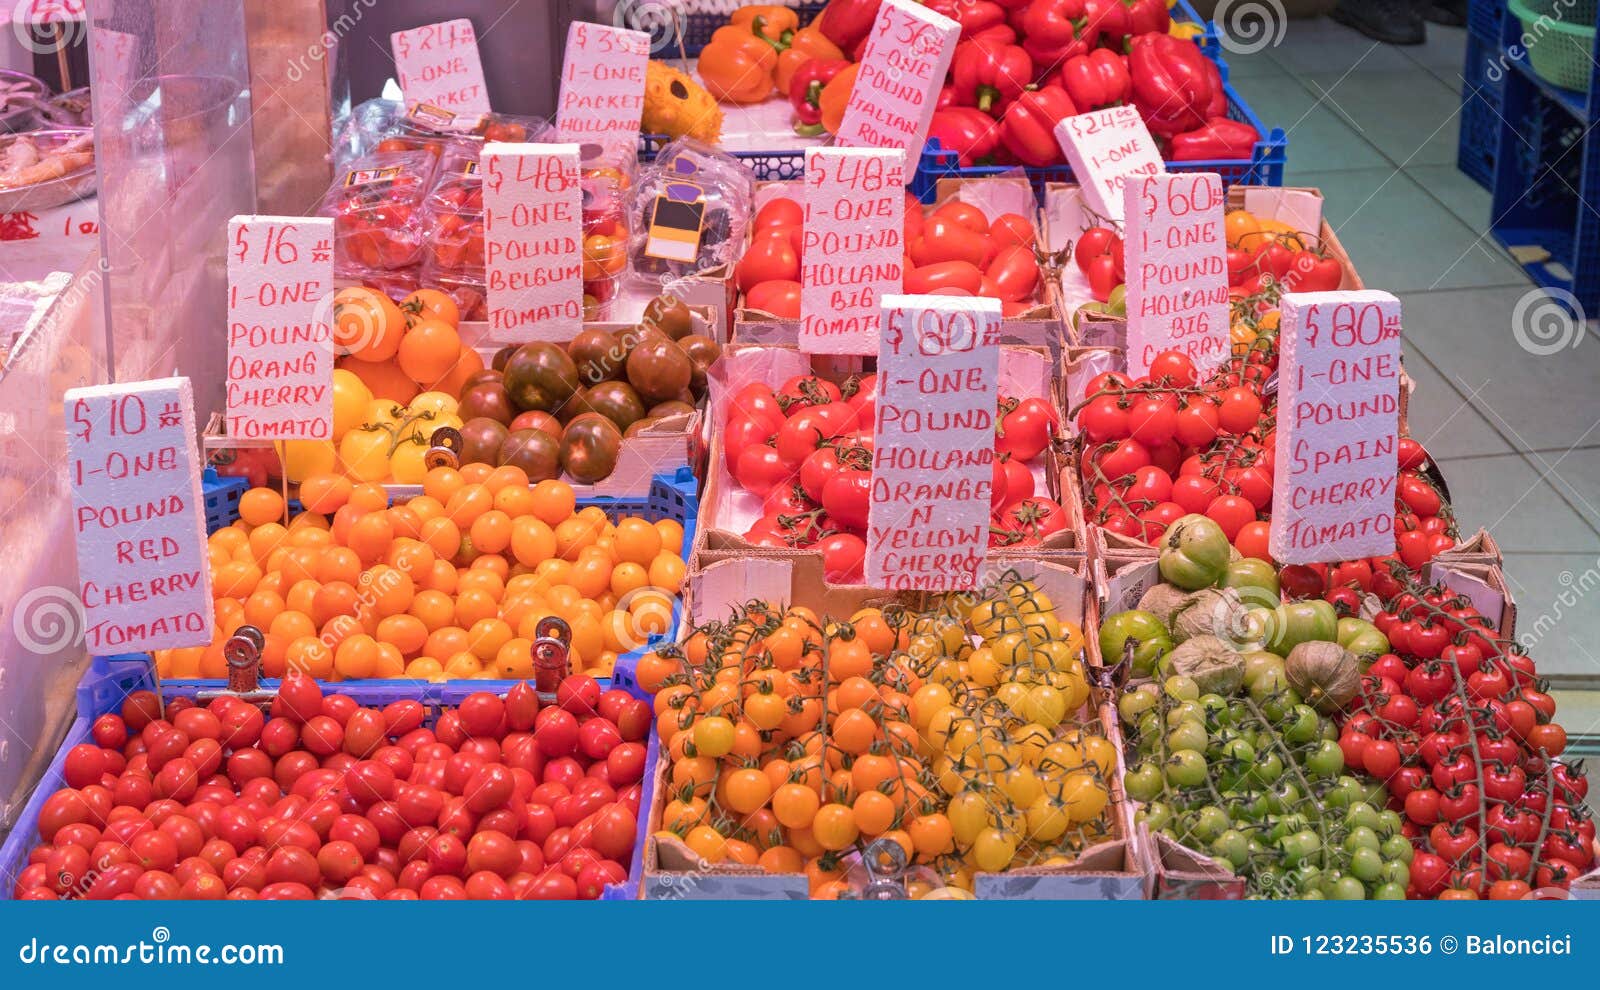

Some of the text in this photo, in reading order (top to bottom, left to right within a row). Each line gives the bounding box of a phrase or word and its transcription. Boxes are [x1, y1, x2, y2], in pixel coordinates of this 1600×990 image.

[860, 63, 923, 105] POUND
[565, 91, 644, 110] PACKET
[848, 89, 918, 135] ITALIAN
[561, 117, 640, 132] HOLLAND
[487, 237, 577, 265] POUND
[803, 229, 899, 256] POUND
[490, 264, 581, 292] BELGUM
[802, 263, 900, 289] HOLLAND
[1142, 256, 1223, 291] POUND
[831, 287, 874, 311] BIG
[1141, 287, 1228, 318] HOLLAND
[490, 300, 579, 329] TOMATO
[1170, 312, 1210, 340] BIG
[230, 323, 330, 349] POUND
[229, 351, 317, 381] ORANG
[1143, 336, 1226, 367] CRRY
[228, 383, 326, 409] CHERRY
[878, 404, 991, 435] POUND
[1296, 394, 1397, 429] POUND
[228, 415, 328, 438] TOMATO
[874, 446, 994, 471] HOLLAND
[1290, 434, 1394, 476] SPAIN
[871, 477, 992, 504] ORANGE
[1291, 475, 1395, 511] CHERRY
[77, 495, 184, 532] POUND
[908, 504, 936, 528] N
[872, 525, 982, 552] YELLOW
[1287, 513, 1392, 549] TOMATO
[116, 536, 180, 565] RED
[81, 571, 200, 609] CHERRY
[85, 612, 204, 647] TOMATO
